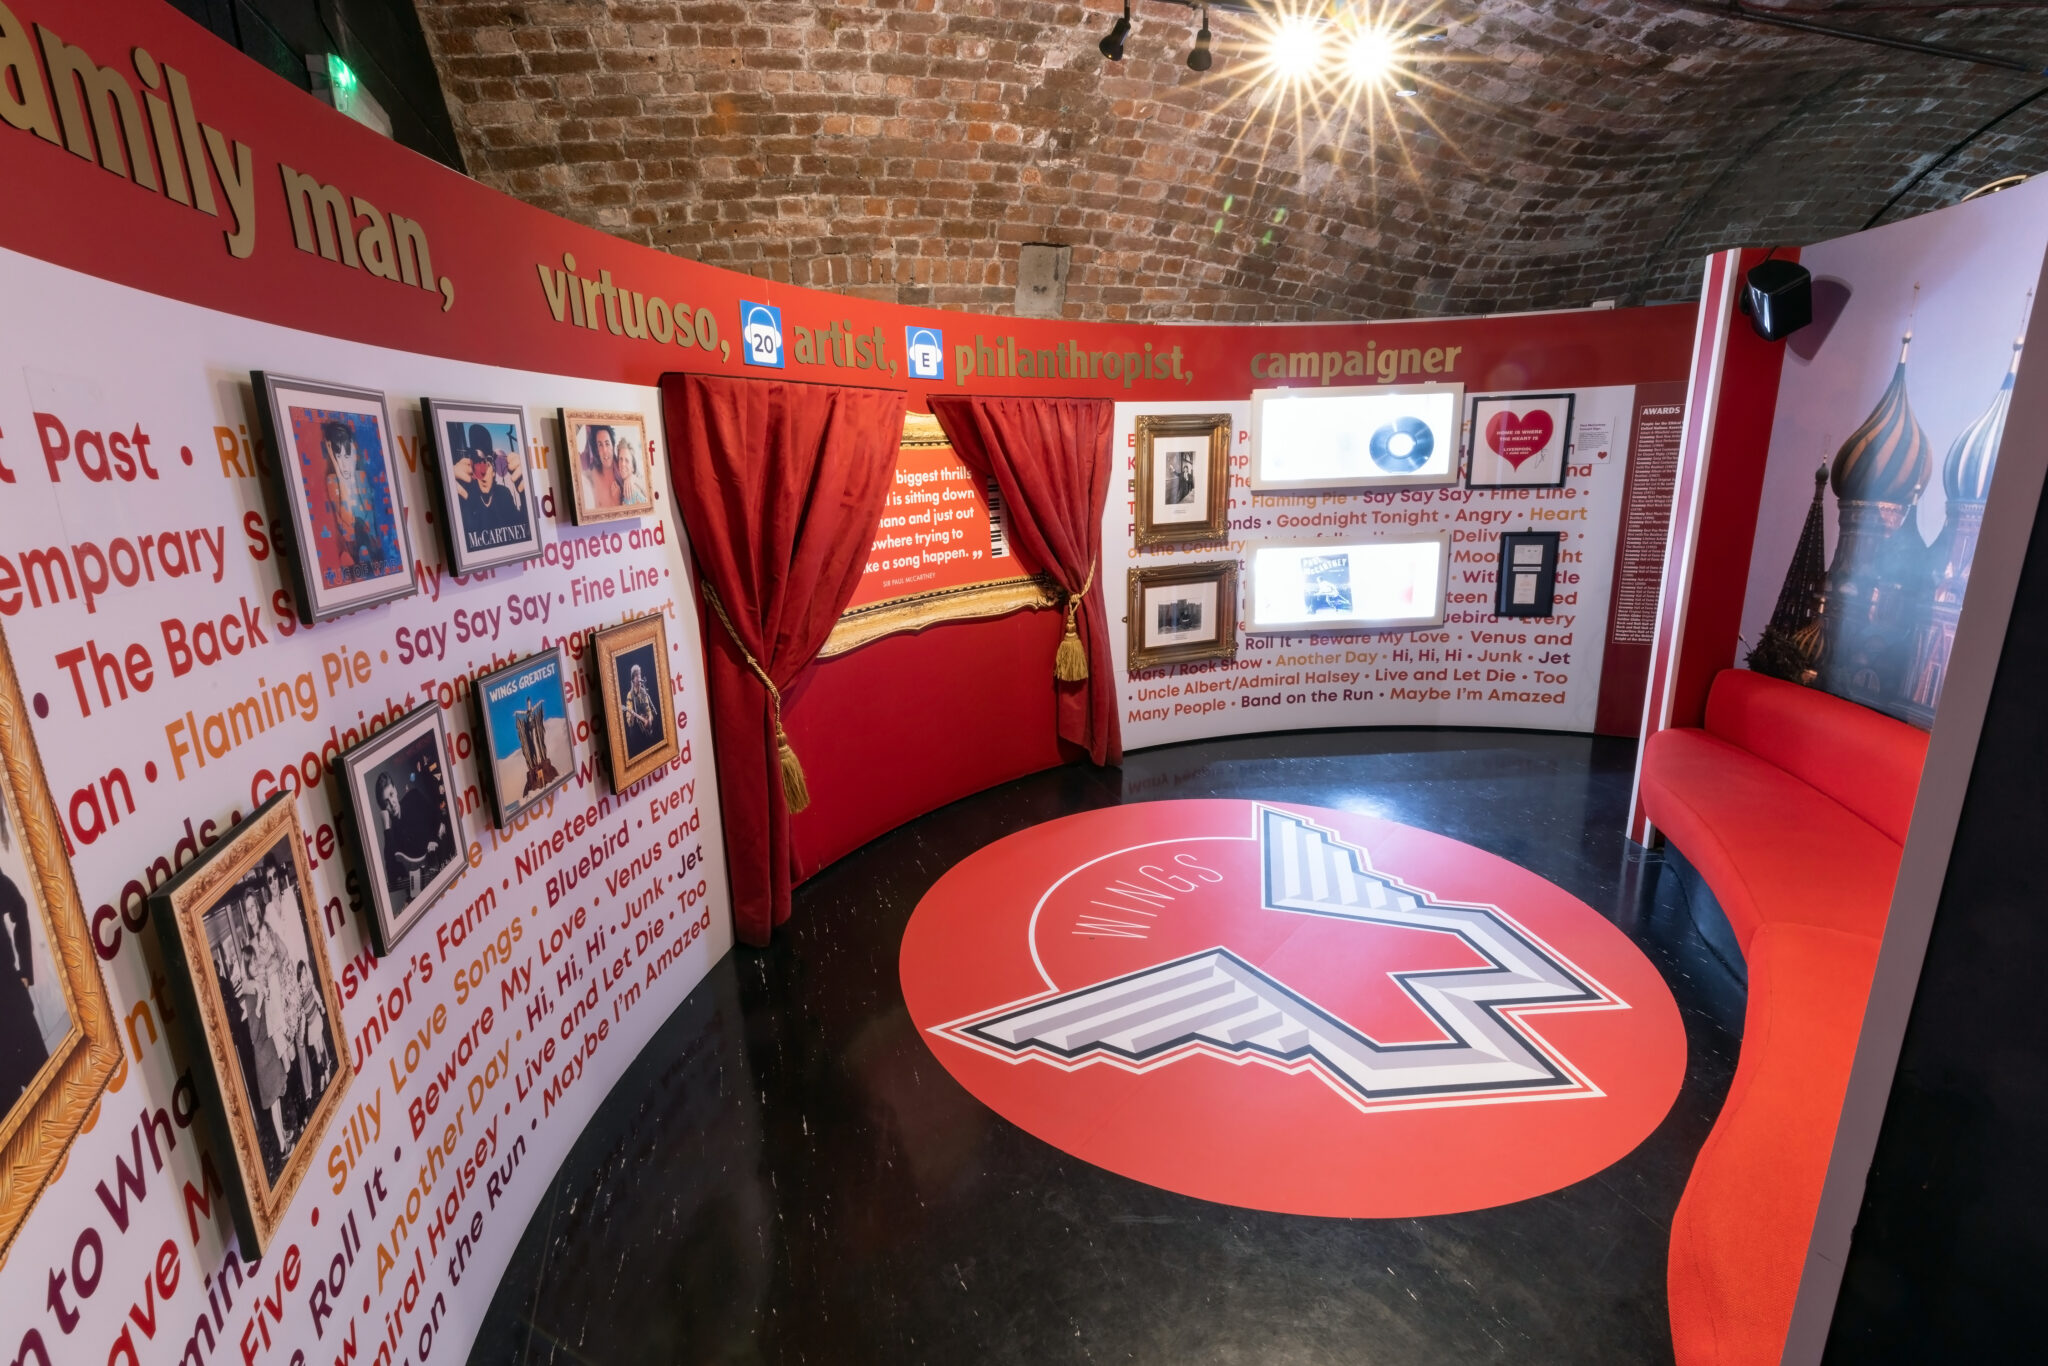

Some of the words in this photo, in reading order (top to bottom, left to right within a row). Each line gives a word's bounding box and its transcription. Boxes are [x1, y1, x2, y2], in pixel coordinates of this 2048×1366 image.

[278, 162, 454, 312] man,
[536, 252, 730, 364] virtuoso,
[794, 320, 898, 377] artist,
[955, 335, 1193, 388] philanthropist,
[1250, 341, 1462, 385] campaigner
[754, 333, 774, 355] 20
[922, 352, 930, 368] E
[1643, 407, 1680, 415] AWARDS
[33, 412, 160, 483] Past
[896, 469, 938, 487] biggest
[941, 466, 972, 480] thrills
[893, 492, 902, 505] is
[905, 489, 939, 505] sitting
[942, 487, 974, 500] down
[1252, 493, 1317, 509] Flaming
[1322, 491, 1347, 505] Pie
[1363, 490, 1396, 506] Say
[1400, 489, 1434, 505] Say
[1438, 487, 1473, 504] Say
[1490, 487, 1530, 500] Fine
[1536, 487, 1576, 500] Line
[908, 509, 930, 524] and
[933, 509, 953, 525] just
[956, 507, 974, 519] out
[1277, 512, 1367, 528] Goodnight
[1372, 508, 1438, 527] Tonight
[1455, 509, 1512, 524] Angry
[1530, 507, 1588, 521] Heart
[468, 524, 528, 547] McCARTNEY
[871, 535, 912, 551] owhere
[915, 530, 949, 547] trying
[952, 528, 963, 539] to
[1151, 542, 1174, 556] the
[1181, 539, 1245, 554] Country
[882, 560, 890, 570] a
[893, 555, 920, 569] song
[922, 549, 969, 565] happen.
[892, 578, 904, 586] PAUL
[55, 640, 154, 718] The
[160, 597, 268, 678] Back
[629, 520, 665, 549] and
[1245, 636, 1273, 650] Roll
[1280, 635, 1291, 647] It
[1309, 633, 1371, 646] Beware
[1377, 631, 1404, 645] My
[1410, 631, 1450, 643] Love
[1470, 630, 1527, 644] Venus
[1533, 632, 1572, 646] and
[1128, 669, 1166, 683] Mars
[1179, 661, 1217, 676] Rock
[1221, 658, 1262, 671] Show
[1275, 652, 1341, 667] Another
[1345, 650, 1378, 665] Day
[1392, 649, 1413, 664] Hi,
[1418, 648, 1440, 662] Hi,
[1445, 648, 1462, 662] Hi
[1477, 649, 1522, 663] Junk
[1538, 651, 1571, 665] Jet
[489, 682, 518, 703] WINGS
[518, 663, 556, 691] GREATEST
[1137, 685, 1179, 701] Uncle
[1184, 672, 1300, 695] Albert/Admiral
[1305, 670, 1360, 685] Halsey
[1375, 668, 1408, 681] Live
[1413, 668, 1448, 681] and
[1453, 669, 1480, 681] Let
[1486, 669, 1516, 682] Die
[1533, 670, 1568, 685] Too
[53, 767, 136, 858] an
[164, 671, 319, 781] Flaming
[322, 645, 372, 697] Pie
[395, 622, 447, 665] Say
[454, 605, 501, 643] Say
[507, 592, 551, 625] Say
[570, 574, 615, 607] Fine
[620, 565, 659, 594] Line
[1128, 707, 1169, 723] Many
[1174, 699, 1226, 715] People
[1241, 693, 1281, 708] Band
[1286, 693, 1306, 704] on
[1311, 690, 1337, 702] the
[1343, 689, 1373, 701] Run
[1390, 687, 1450, 703] Maybe
[1456, 687, 1482, 700] I'm
[1488, 688, 1566, 704] Amazed
[1072, 853, 1223, 939] WINGS
[353, 952, 433, 1076] unior's
[436, 887, 497, 963] Farm
[514, 796, 610, 885] Nineteen
[240, 1244, 301, 1366] Five
[327, 1087, 382, 1195] Silly
[389, 1003, 446, 1095] Love
[454, 917, 522, 1005] Songs
[546, 819, 629, 908] Bluebird
[650, 778, 695, 824] Every
[309, 1208, 361, 1341] Roll
[364, 1166, 388, 1221] It
[408, 1006, 493, 1142] Beware
[501, 957, 531, 1012] My
[538, 906, 586, 966] Love
[605, 841, 662, 897] Venus
[668, 807, 700, 848] and
[375, 1105, 464, 1295] Another
[467, 1038, 509, 1115] Day
[526, 986, 554, 1032] Hi,
[556, 954, 583, 996] Hi,
[586, 925, 606, 964] Hi
[621, 876, 664, 929] Junk
[677, 843, 703, 879] Jet
[427, 1114, 498, 1259] Halsey
[515, 1037, 555, 1102] Live
[561, 978, 599, 1040] and
[602, 947, 632, 992] Let
[635, 918, 664, 957] Die
[678, 879, 707, 913] Too
[418, 1292, 446, 1362] on
[448, 1211, 483, 1286] the
[487, 1135, 526, 1210] Run
[542, 1019, 609, 1118] Maybe
[613, 982, 641, 1023] I'm
[646, 905, 711, 990] Amazed
[47, 1227, 103, 1334] to
